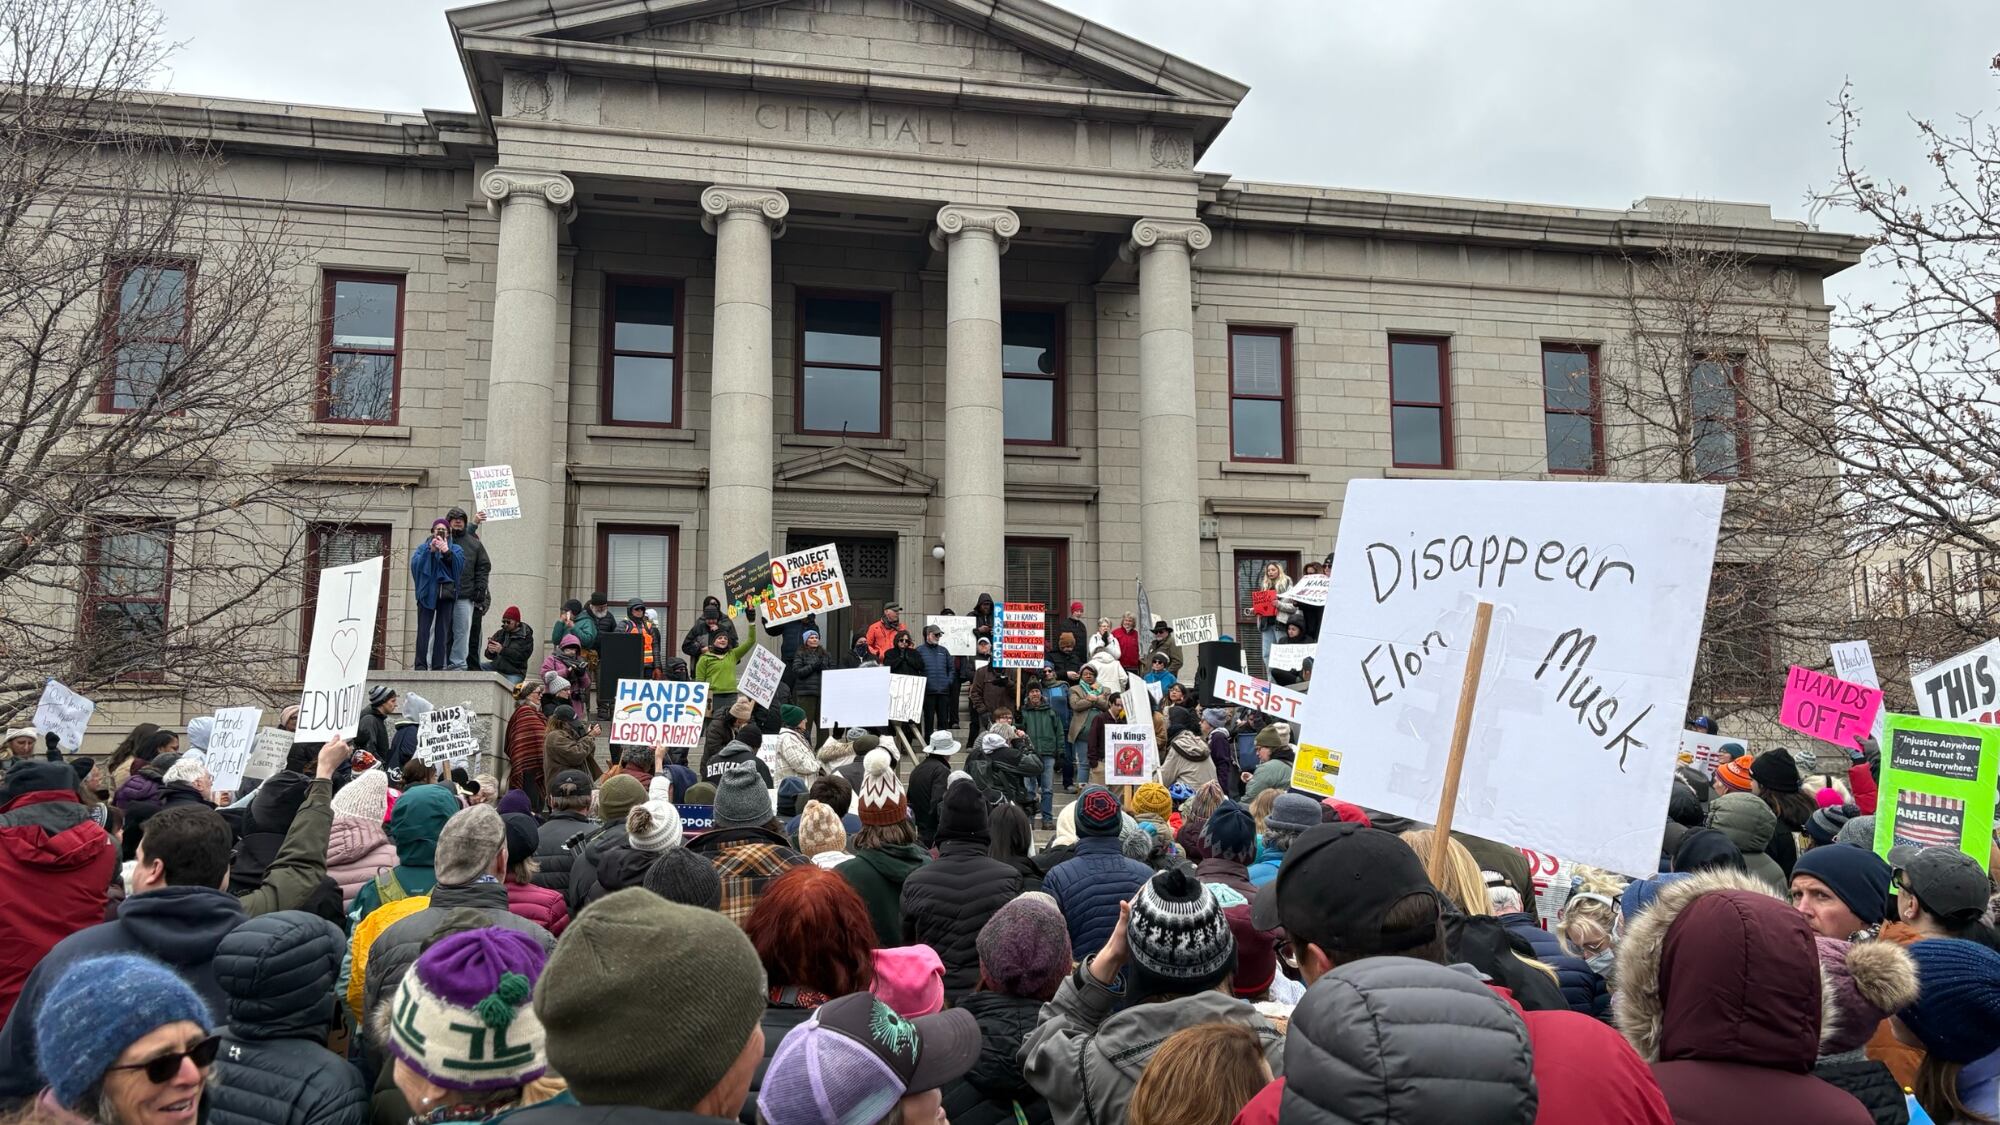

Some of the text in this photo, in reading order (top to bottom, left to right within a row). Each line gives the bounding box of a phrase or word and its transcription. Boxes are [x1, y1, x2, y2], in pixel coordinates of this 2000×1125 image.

[755, 104, 968, 147] CITY HALL
[787, 549, 829, 570] PROJECT
[799, 562, 825, 575] 2025
[1366, 531, 1635, 604] Disappear
[791, 567, 837, 588] FASCISM
[338, 570, 362, 624] I
[767, 581, 844, 621] RESIST!
[1175, 616, 1213, 633] HANDS OFF
[993, 605, 1004, 667] PROTECT
[1175, 629, 1212, 643] MEDICAID
[1005, 659, 1041, 667] DEMOCRACY
[1361, 630, 1448, 705] Elon
[620, 681, 705, 703] HANDS
[1794, 668, 1872, 710] HANDS
[1924, 655, 1996, 718] THIS
[1226, 680, 1302, 718] RESIST
[1534, 628, 1656, 773] Musk
[215, 712, 243, 730] Hands
[430, 707, 461, 723] HANDS
[646, 702, 685, 722] OFF
[1797, 701, 1860, 740] OFF
[436, 722, 451, 733] OFF
[611, 722, 701, 745] LGBTQ RIGHTS
[1111, 731, 1146, 741] No Kings
[431, 740, 465, 753] OPEN SPACES
[1911, 747, 1966, 761] Is A Threat To
[1940, 740, 1980, 751] Anywhere
[208, 752, 243, 779] Rights!
[1893, 756, 1924, 767] Justice
[1896, 806, 1960, 826] AMERICA
